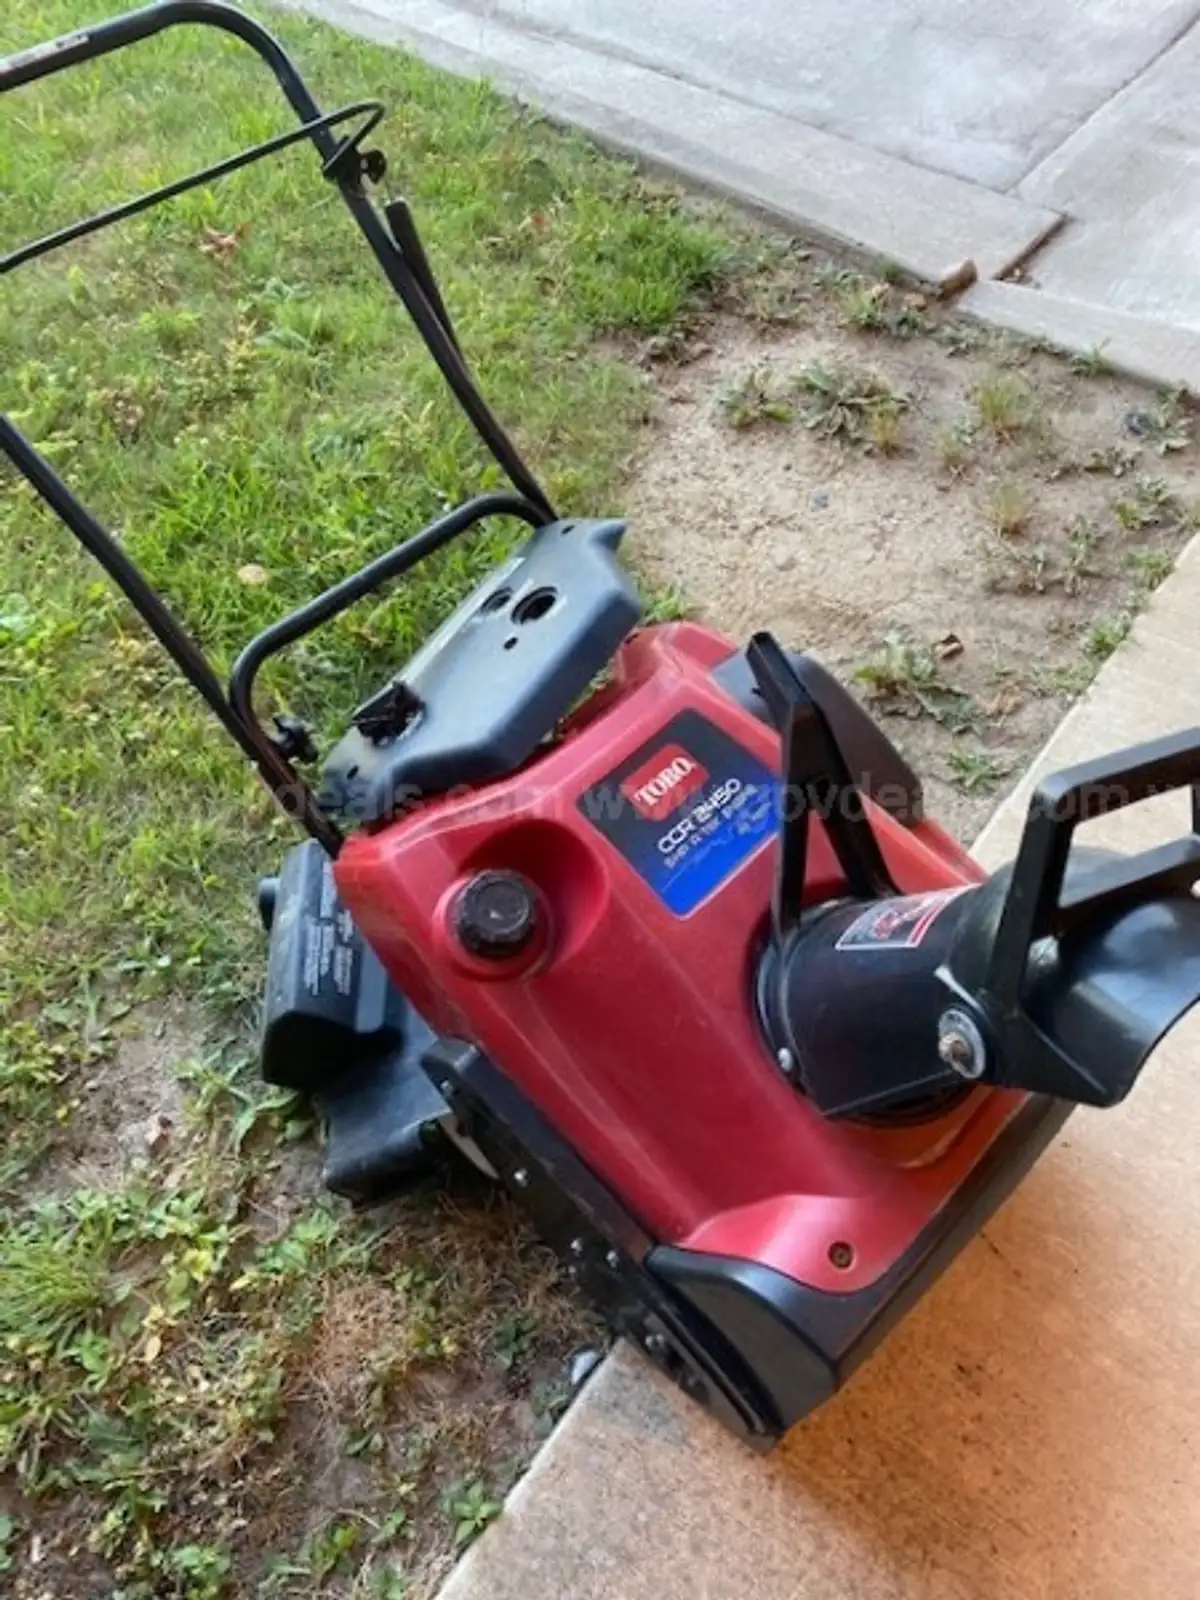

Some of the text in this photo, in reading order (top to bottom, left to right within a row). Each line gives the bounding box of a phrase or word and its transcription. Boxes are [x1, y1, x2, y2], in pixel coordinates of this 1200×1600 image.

[634, 757, 698, 806] TORO
[658, 818, 696, 853] CCR
[692, 778, 741, 822] 2450
